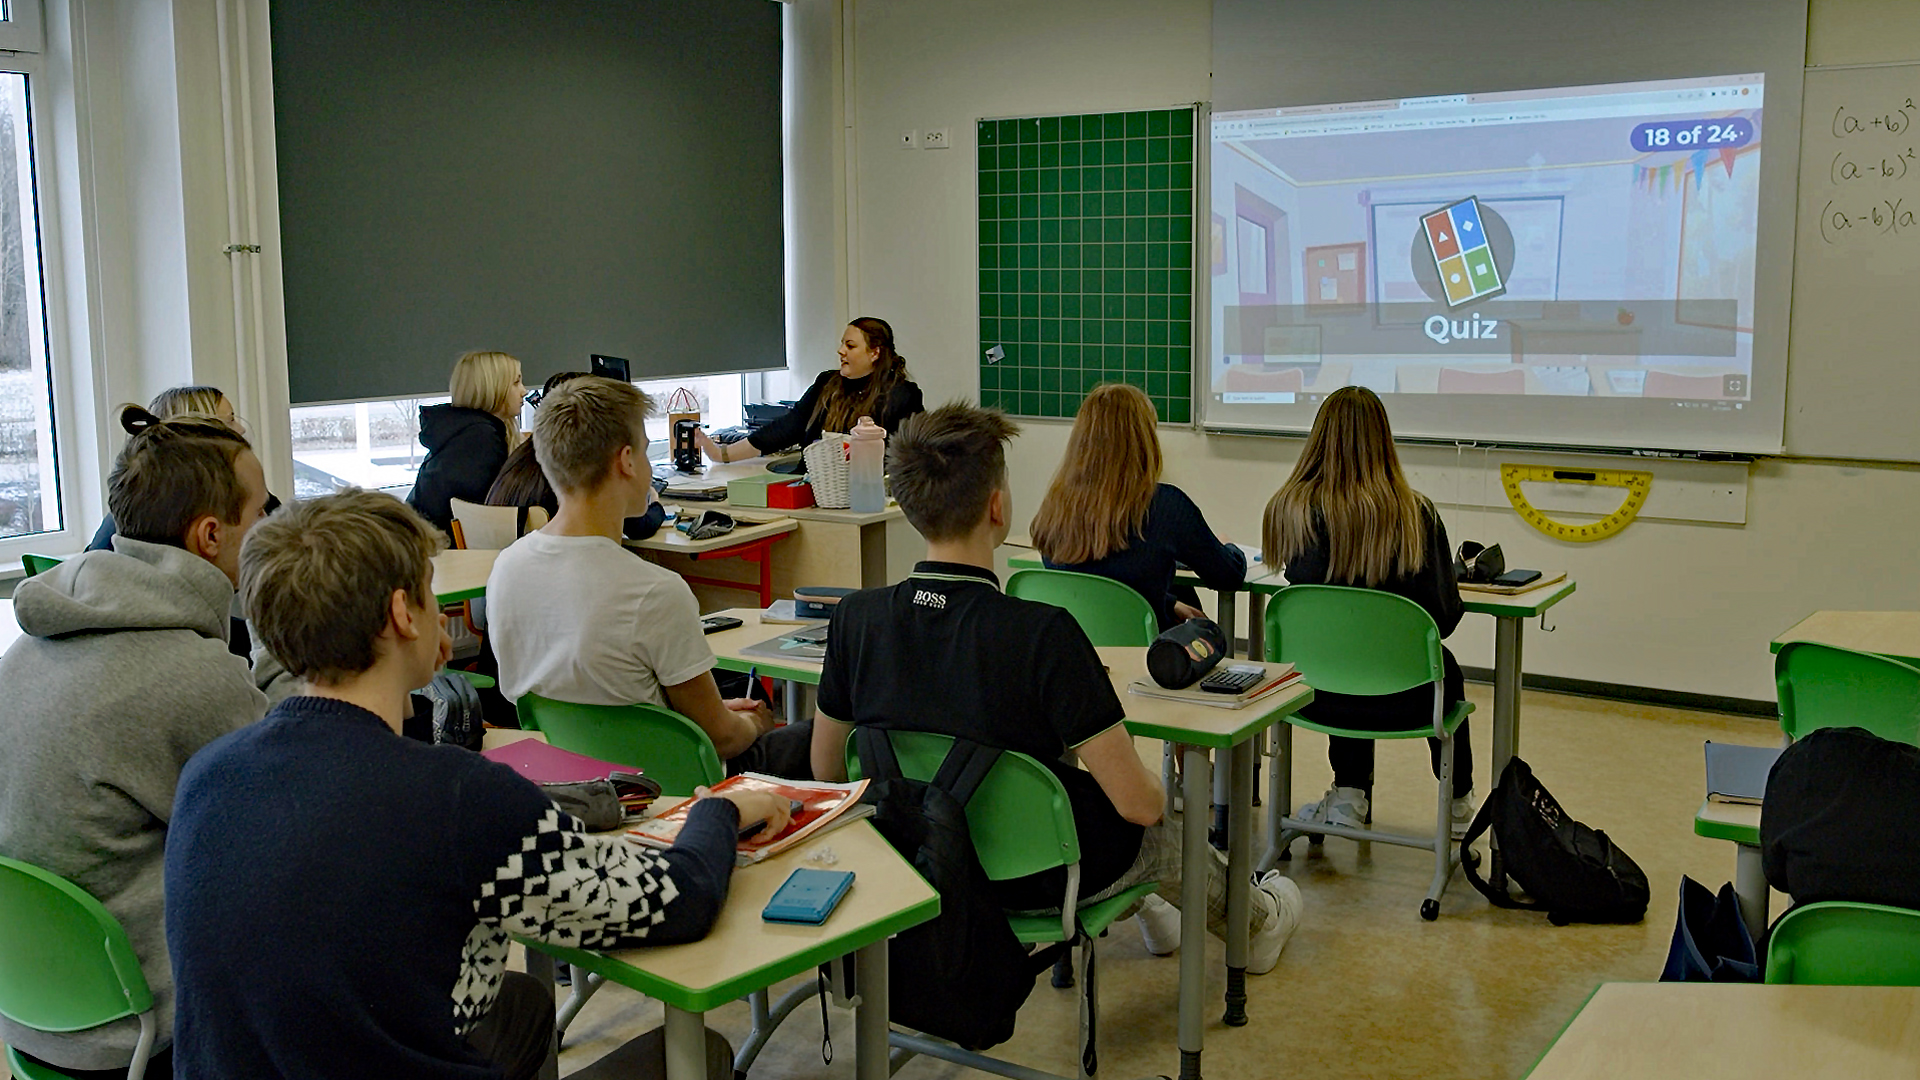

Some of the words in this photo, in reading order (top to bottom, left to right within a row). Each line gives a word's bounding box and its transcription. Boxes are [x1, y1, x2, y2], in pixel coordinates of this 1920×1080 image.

[1645, 128, 1671, 146] 18
[1676, 125, 1702, 145] of
[1707, 124, 1738, 144] 24
[1424, 312, 1498, 345] Quiz
[914, 590, 946, 606] BOSS
